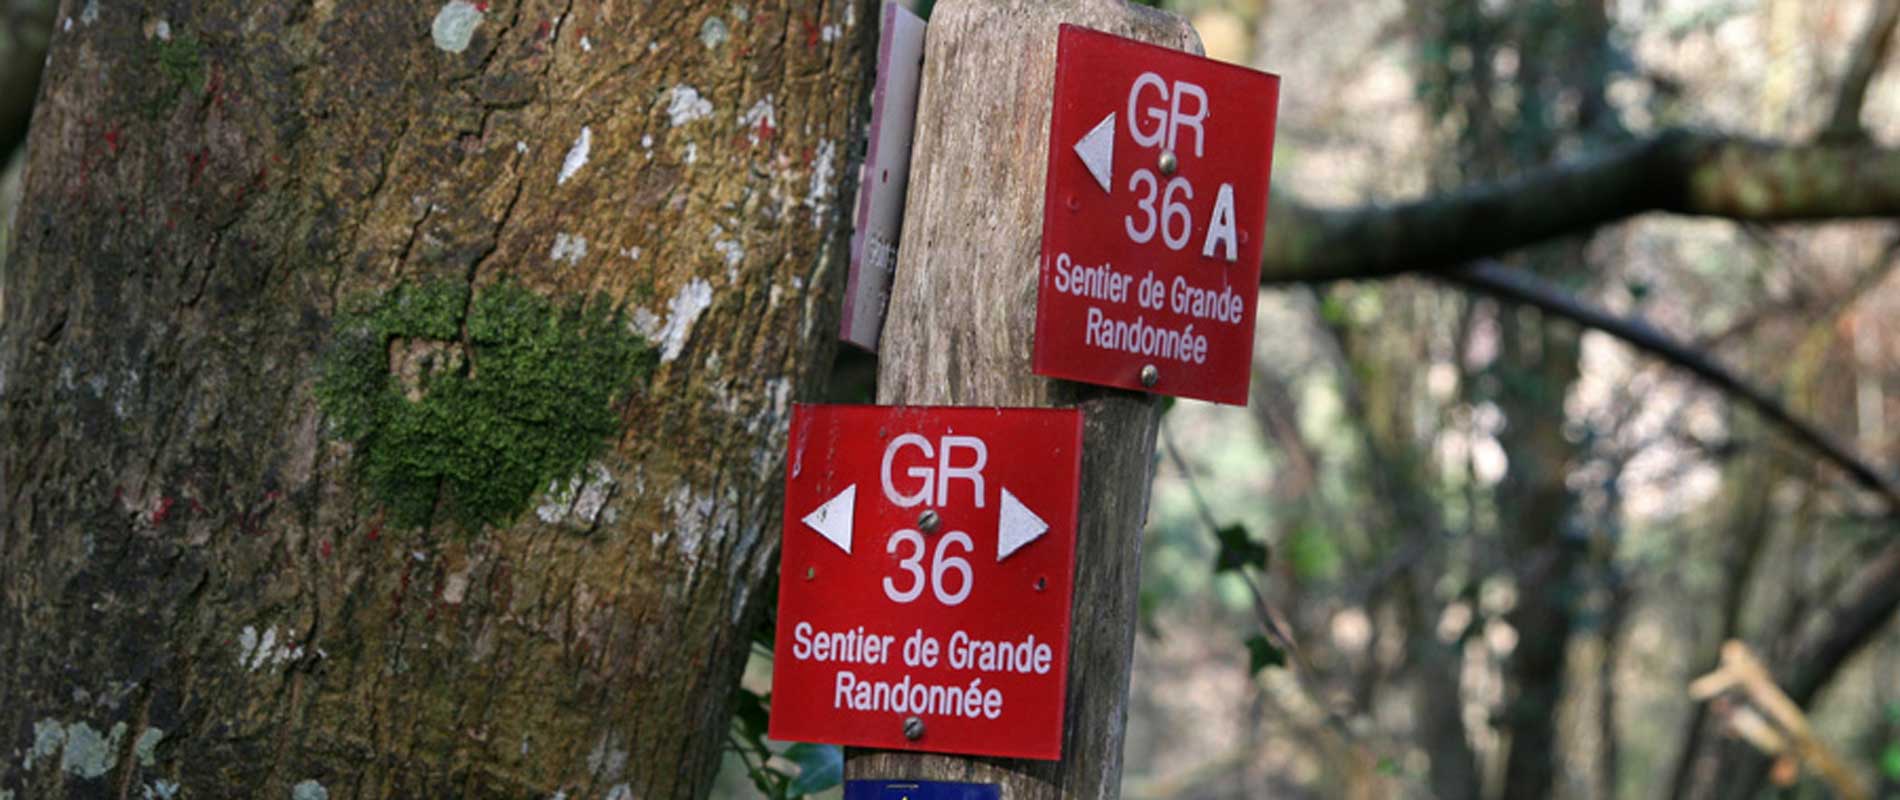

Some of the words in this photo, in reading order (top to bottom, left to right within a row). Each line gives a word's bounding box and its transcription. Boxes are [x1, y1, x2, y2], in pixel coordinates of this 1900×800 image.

[1127, 72, 1209, 157] GR
[1125, 168, 1193, 250] 36
[1202, 183, 1238, 261] A
[1055, 253, 1132, 303] Sentier
[1138, 271, 1165, 309] de
[1171, 275, 1243, 324] Grande
[1085, 308, 1207, 364] Randonnée
[881, 433, 988, 508] GR
[883, 529, 974, 606] 36
[793, 622, 895, 664] Sentier
[903, 629, 940, 668] de
[949, 631, 1052, 674] Grande
[834, 671, 1003, 719] Randonnée
